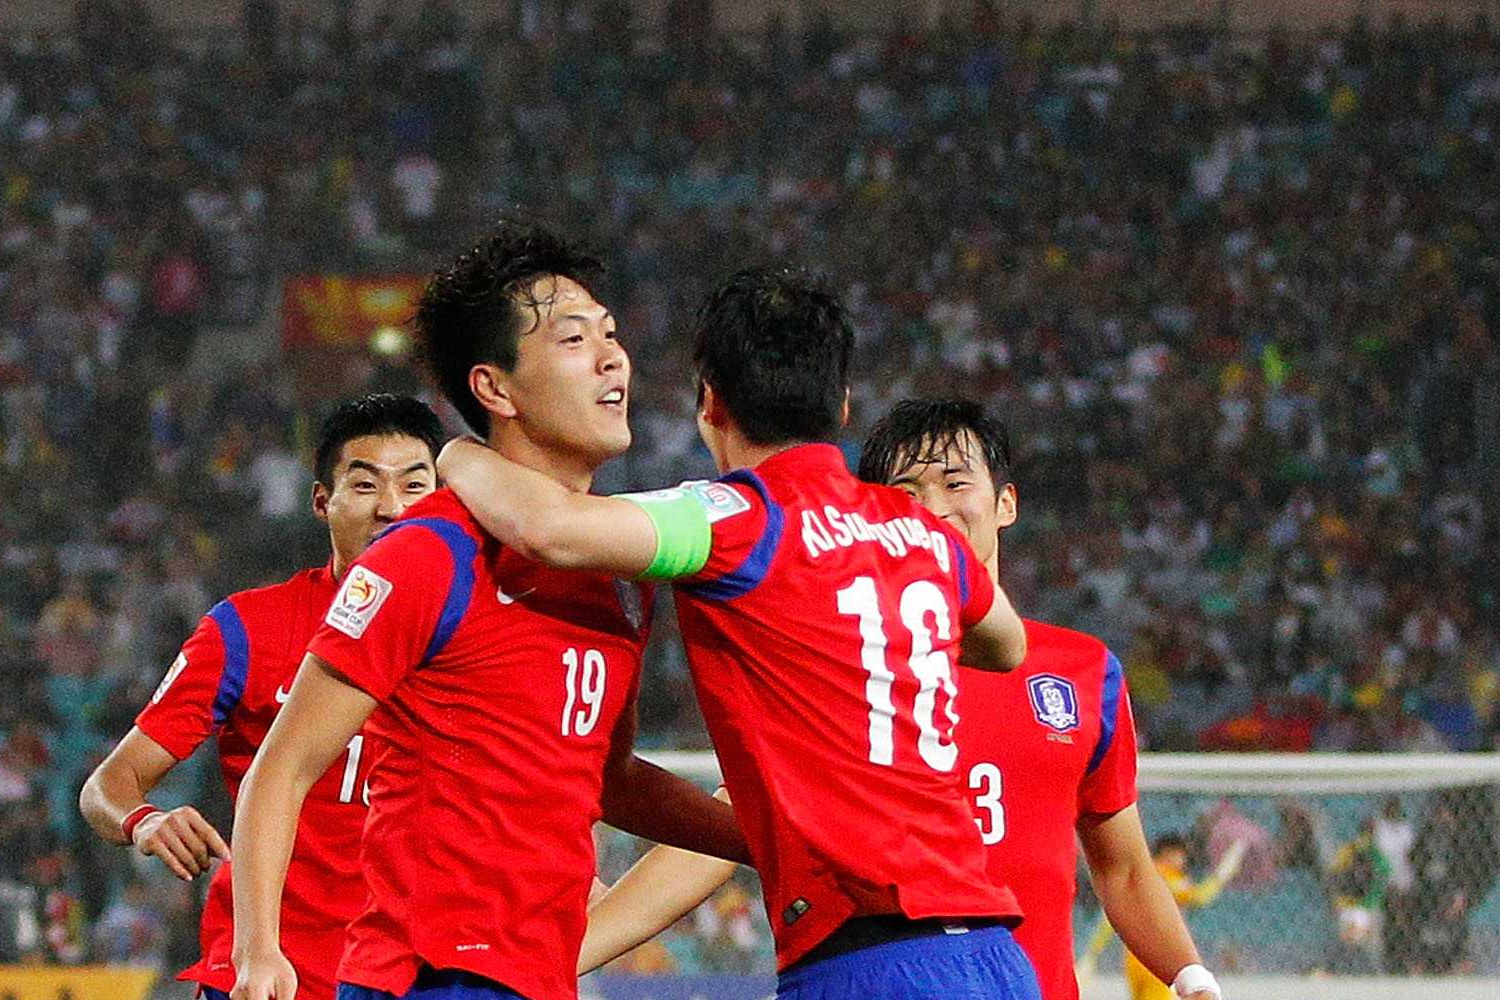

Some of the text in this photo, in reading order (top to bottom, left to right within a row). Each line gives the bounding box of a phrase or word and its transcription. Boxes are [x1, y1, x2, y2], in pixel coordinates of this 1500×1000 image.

[561, 647, 607, 737] 19
[836, 575, 960, 773] 16
[339, 735, 371, 808] 1
[968, 762, 1007, 846] 3
